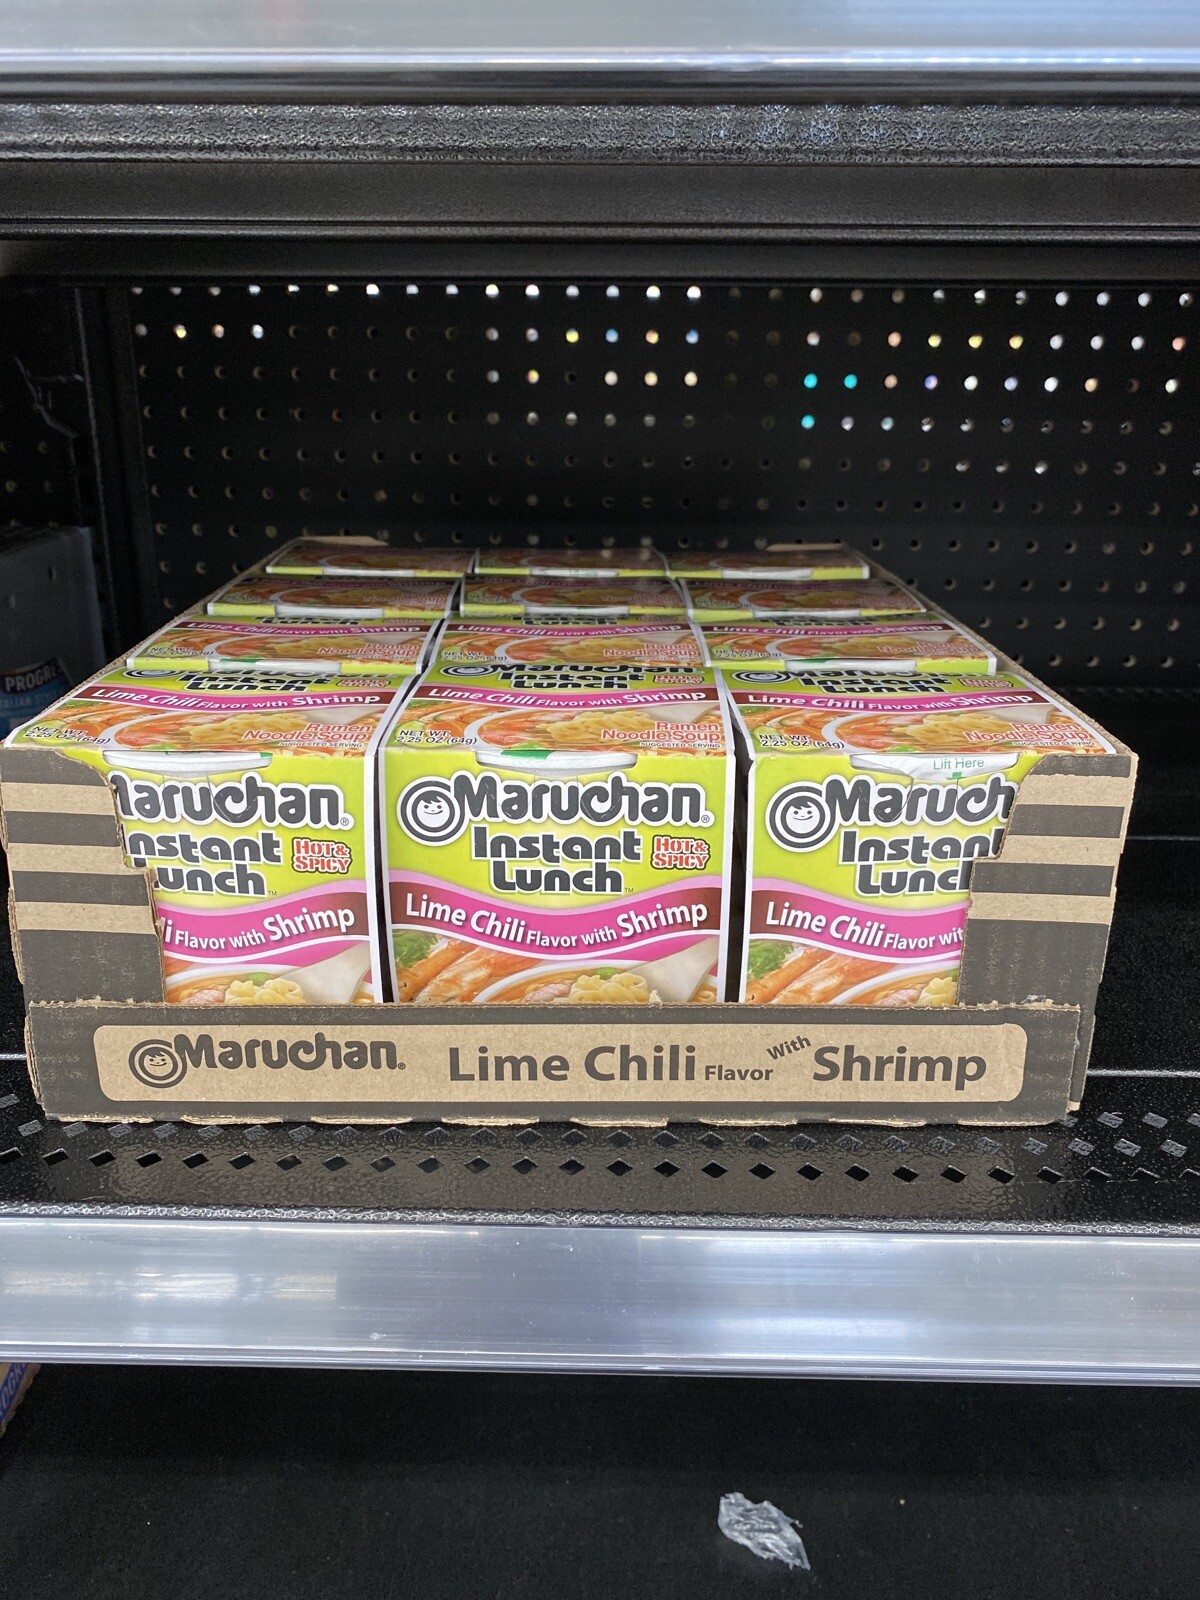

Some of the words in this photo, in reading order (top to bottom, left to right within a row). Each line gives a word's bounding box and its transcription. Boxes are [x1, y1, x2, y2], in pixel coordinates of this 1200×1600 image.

[350, 625, 420, 634] Shrimp
[616, 625, 681, 634] Shrimp
[500, 672, 645, 682] Instant
[513, 680, 628, 689] Lunch
[186, 681, 306, 691] Lunch
[822, 684, 946, 693] Lunch
[92, 688, 148, 701] Lime
[148, 695, 202, 707] Chili
[196, 701, 248, 709] Flavor
[252, 700, 288, 708] with
[292, 695, 381, 706] Shrimp
[428, 688, 483, 700] Lime
[486, 693, 537, 705] Chili
[535, 699, 585, 707] Flavor
[622, 692, 706, 703] Shrimp
[747, 694, 806, 704] Lime
[811, 698, 864, 709] Chili
[868, 703, 918, 711] Flavor
[922, 701, 957, 710] with
[950, 694, 1033, 705] Shrimp
[305, 722, 372, 732] Ramen
[399, 729, 424, 737] NET
[655, 722, 719, 732] Ramen
[1010, 722, 1080, 732] Ramen
[242, 730, 316, 740] Noodle
[317, 732, 368, 742] Soup
[395, 735, 427, 744] 2.25
[430, 735, 446, 744] OZ
[446, 735, 477, 745] (64g)
[602, 729, 668, 741] Noodle
[670, 731, 721, 742] Soup
[963, 730, 1035, 742] Noodle
[1036, 731, 1090, 743] Soup
[812, 740, 845, 749] (64g)
[933, 759, 952, 770] Lift
[955, 758, 984, 769] Here
[454, 774, 702, 825] Maruchan
[824, 775, 1018, 824] Maruch
[127, 832, 282, 865] nstant
[474, 826, 641, 864] Instant
[293, 855, 350, 873] SPICY
[652, 852, 709, 869] SPICY
[150, 865, 266, 896] unch
[493, 861, 623, 893] Lunch
[175, 930, 226, 951] Flavor
[229, 929, 266, 948] with
[263, 906, 355, 941] Shrimp
[406, 893, 471, 926] Lime
[470, 910, 527, 943] Chili
[526, 929, 578, 949] Flavor
[580, 928, 618, 946] with
[616, 902, 708, 938] Shrimp
[765, 901, 826, 933] Lime
[829, 914, 886, 948] Chili
[883, 932, 936, 951] Flavor
[939, 926, 964, 946] wit
[173, 1032, 398, 1072] Maruchan
[449, 1047, 569, 1083] Lime
[584, 1044, 697, 1082] Chili
[704, 1064, 774, 1082] Flavor
[765, 1035, 812, 1062] With
[812, 1045, 987, 1092] Shrimp
